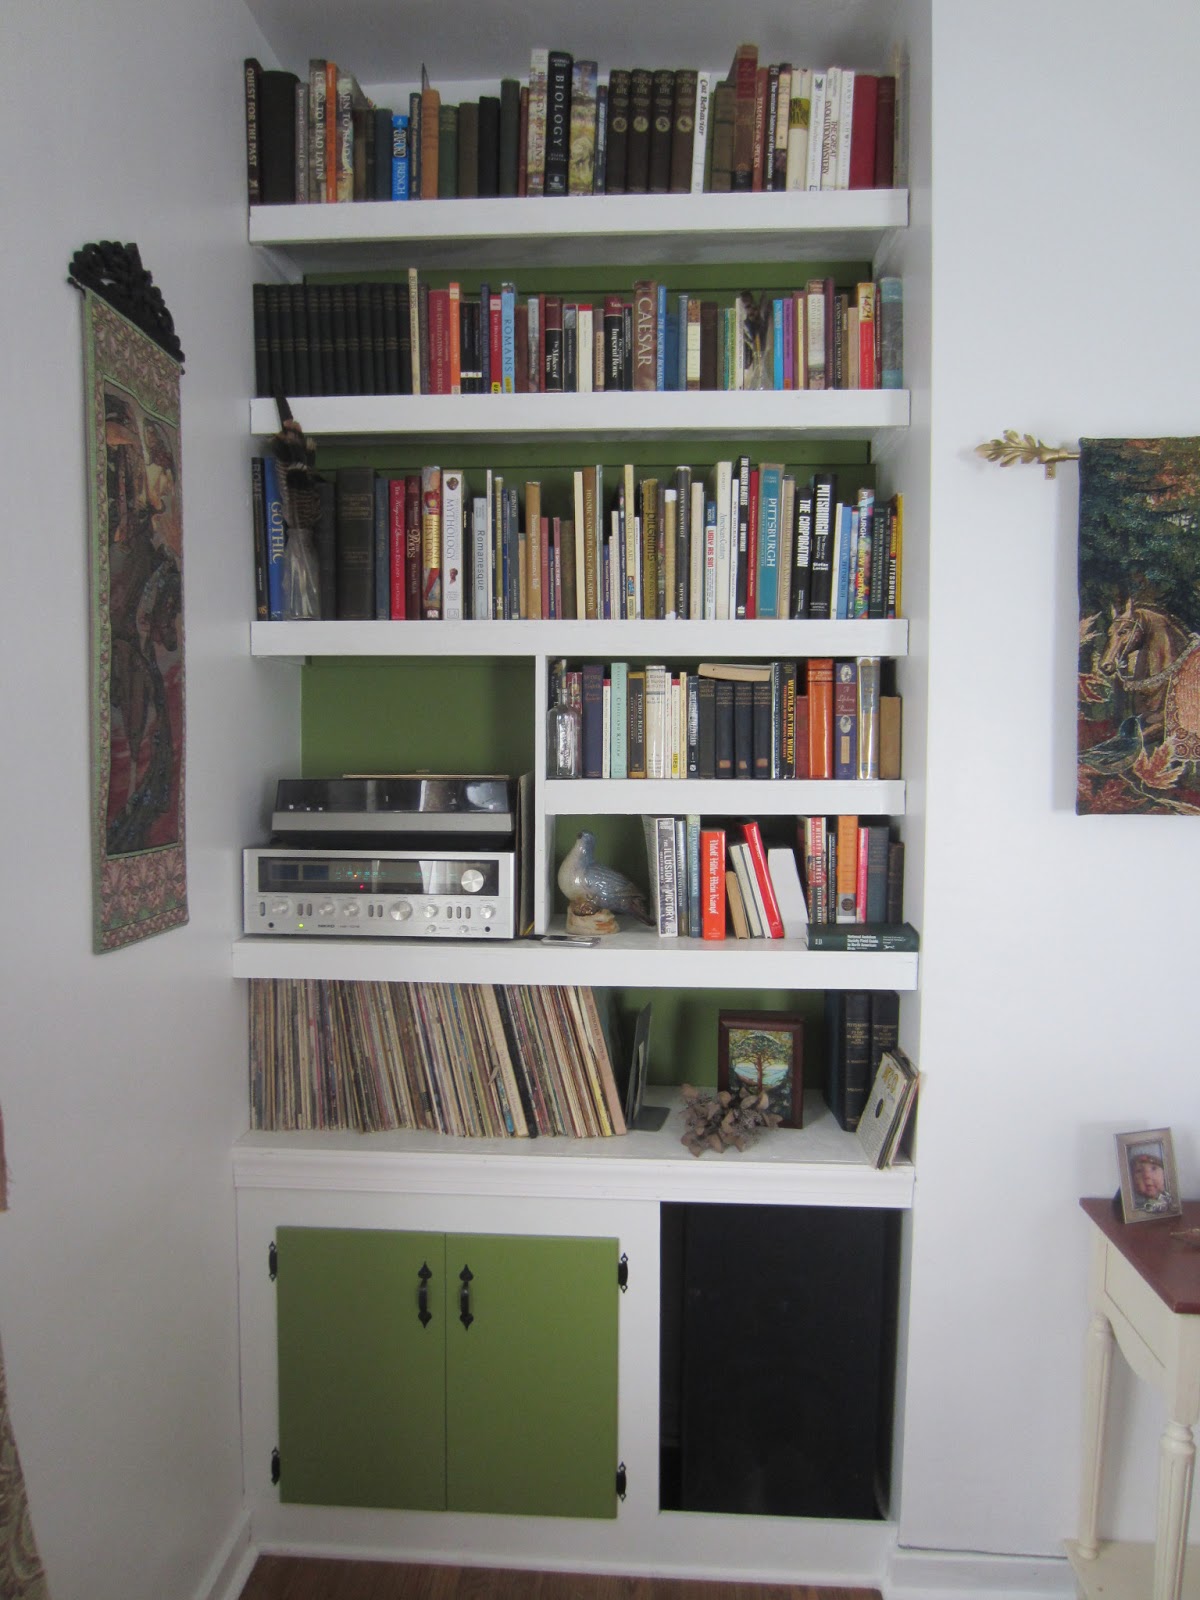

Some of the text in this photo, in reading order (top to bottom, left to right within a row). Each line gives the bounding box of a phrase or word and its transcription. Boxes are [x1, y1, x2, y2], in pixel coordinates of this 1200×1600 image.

[247, 68, 255, 99] QUEST
[315, 71, 323, 102] LEARN
[315, 106, 324, 120] TO
[554, 75, 565, 146] BIOLOGY
[699, 79, 708, 135] Cat Behavior
[249, 143, 257, 166] PAST
[394, 130, 406, 157] OXFORD
[535, 133, 544, 168] PLANTS
[822, 143, 830, 175] MYSTERY
[316, 152, 324, 180] LATIN
[397, 162, 406, 194] FRENCH
[861, 296, 872, 318] 1421
[504, 319, 513, 372] ROMANS
[637, 297, 652, 368] CAESAR
[437, 358, 442, 366] OF
[740, 486, 748, 505] BEATLES
[815, 484, 830, 535] PITTSBURGH
[271, 501, 284, 564] GOTHIC
[446, 499, 455, 560] MYTHOLOGY
[767, 498, 777, 567] PITTSBURGH
[860, 492, 868, 538] PITTSBURGH
[425, 519, 433, 564] HISTORY
[646, 512, 656, 561] PILGRIMS
[719, 513, 727, 560] American Century
[797, 499, 810, 567] THE CORPORATION
[476, 530, 485, 590] Romanesque
[708, 547, 714, 555] AS
[842, 552, 847, 561] IN
[783, 567, 791, 583] AND
[888, 559, 896, 605] PITTSBURGH
[788, 713, 794, 721] IN
[664, 848, 672, 883] ILLUSION
[709, 840, 718, 914] Adolf Hitler Mein Kampf
[664, 889, 673, 921] VICTORY
